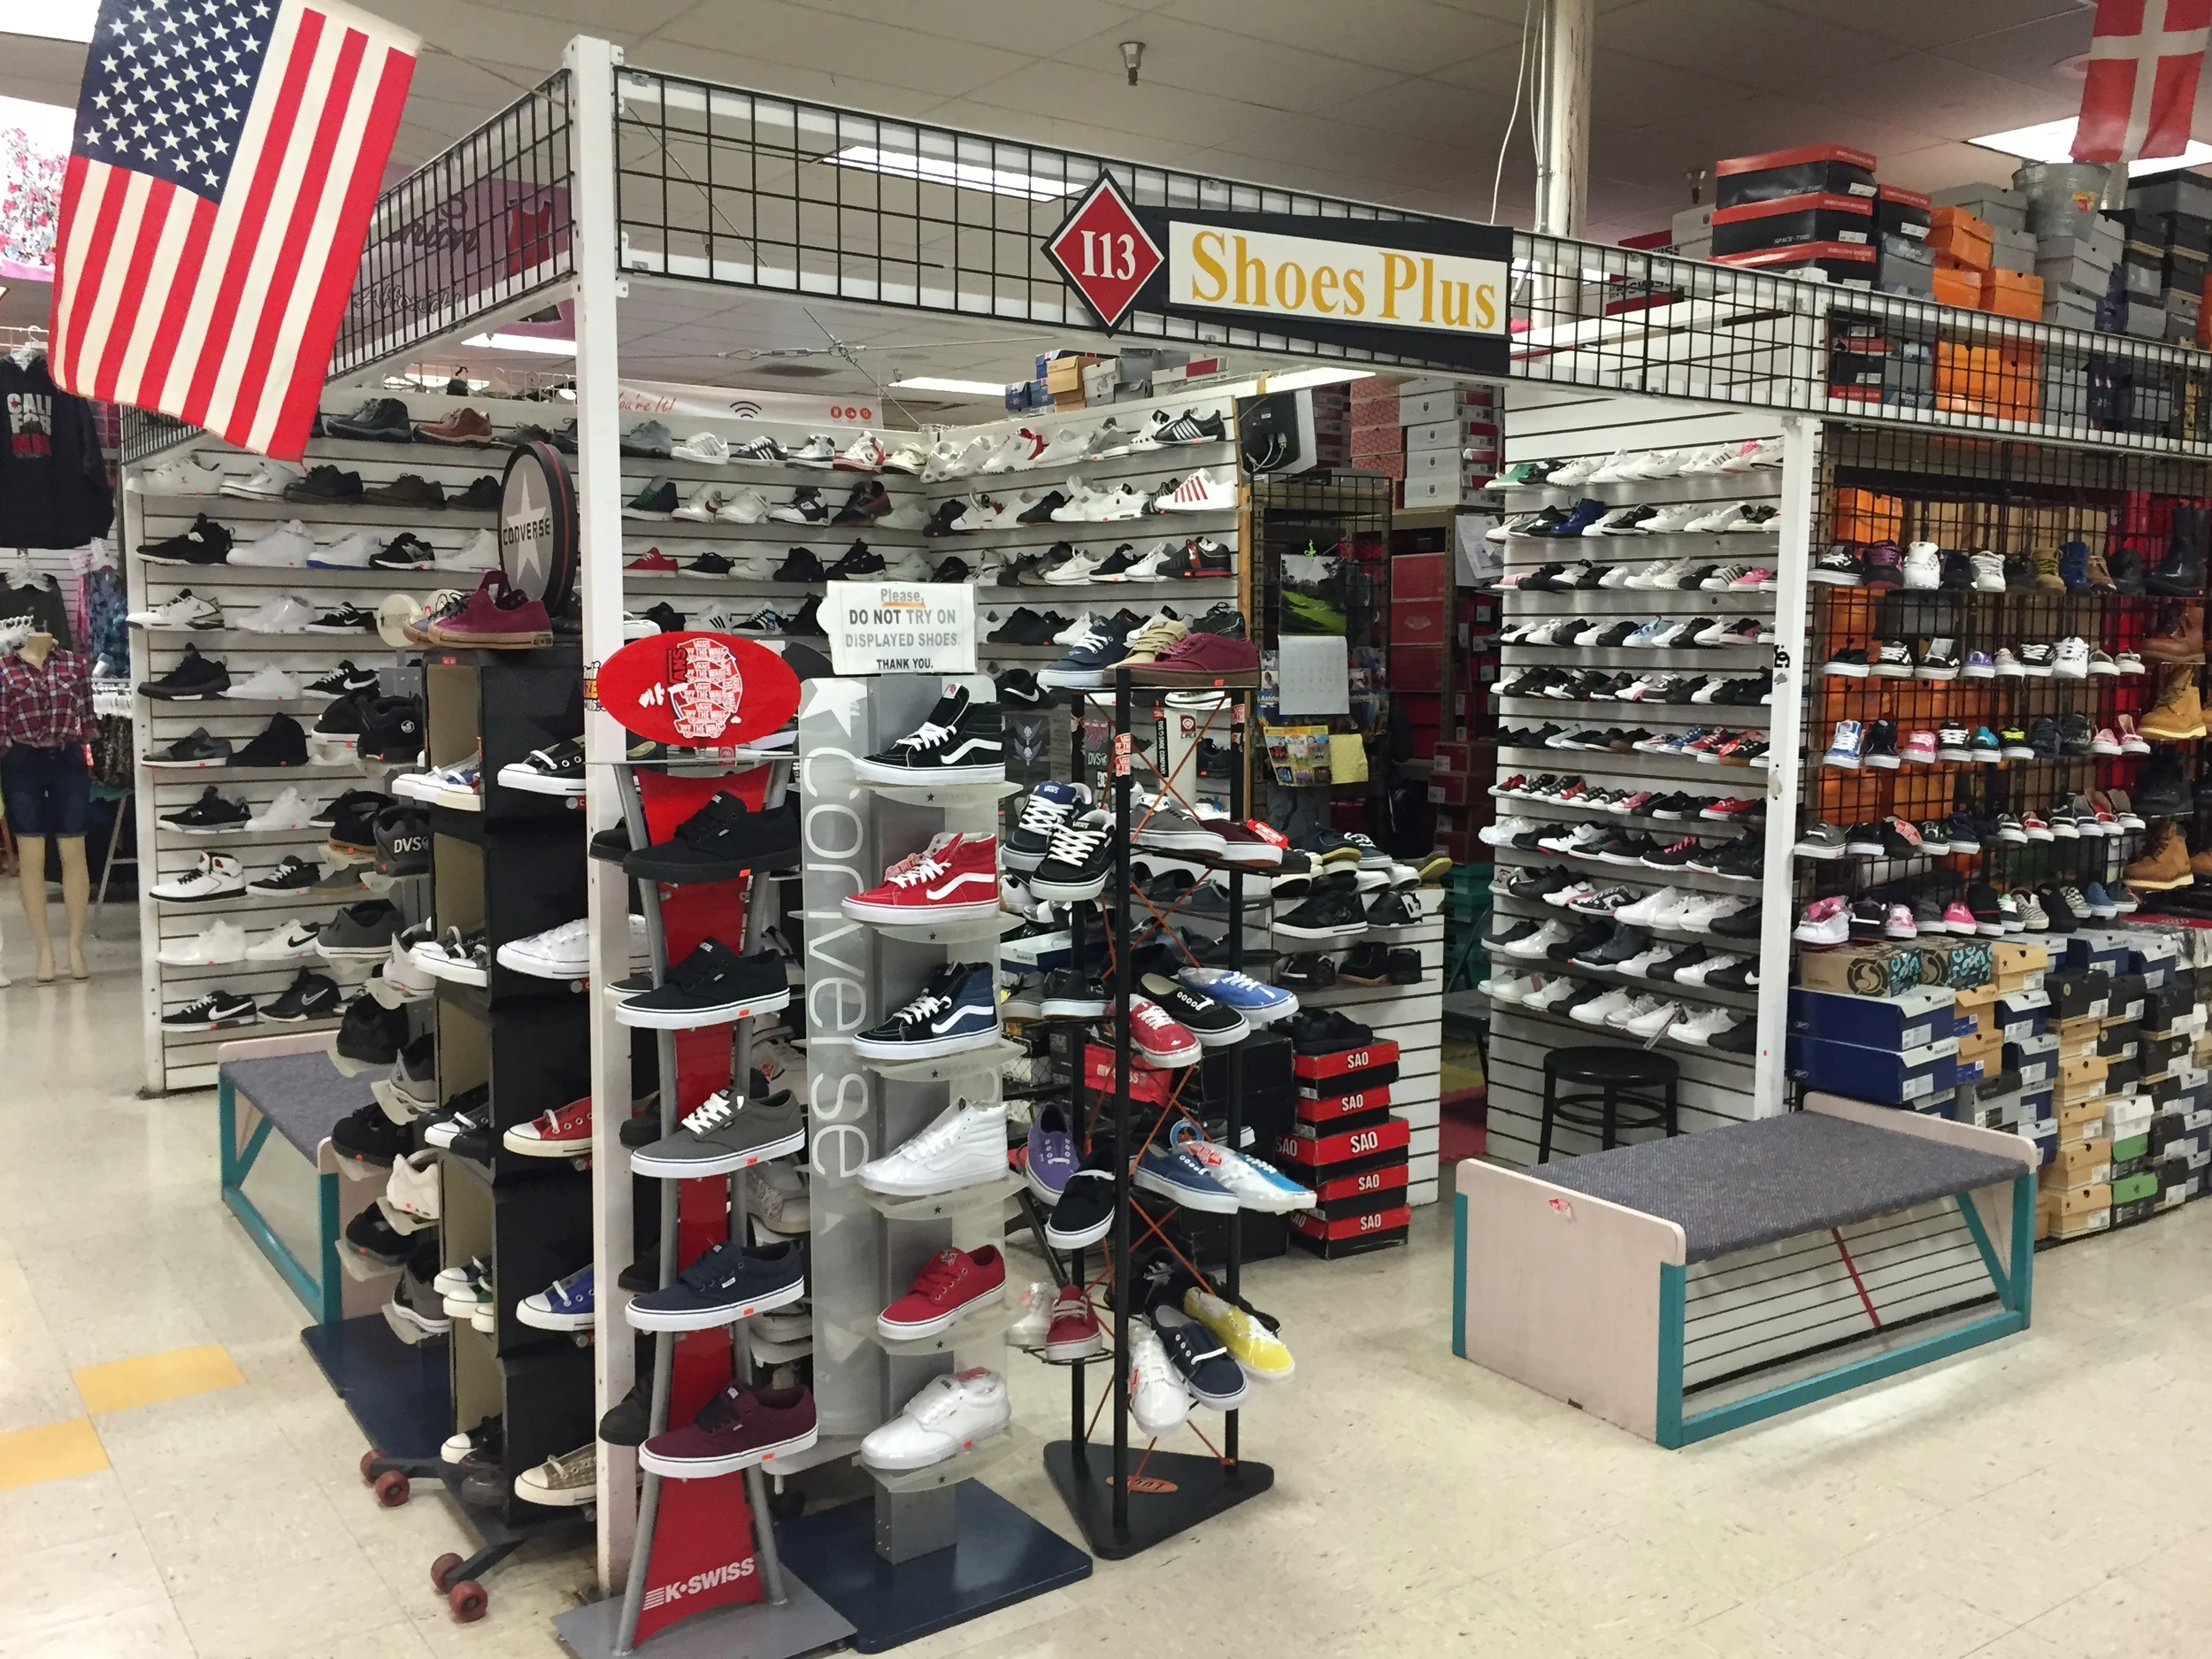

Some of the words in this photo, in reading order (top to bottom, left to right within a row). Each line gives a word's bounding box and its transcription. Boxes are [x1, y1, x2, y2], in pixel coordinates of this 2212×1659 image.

[1191, 230, 1365, 317] Shoes
[1377, 251, 1496, 330] Plus
[7, 393, 52, 416] CALI
[503, 518, 550, 546] CONVERSE
[880, 588, 925, 604] Please,
[849, 609, 868, 625] DO
[873, 609, 902, 625] NOT
[906, 609, 933, 625] TRY
[937, 609, 956, 625] ON
[876, 658, 910, 670] THANK
[913, 657, 933, 669] YOU.
[394, 836, 422, 854] DVS
[1347, 1051, 1370, 1069] SAO
[1341, 1094, 1363, 1111] SAO
[1349, 1131, 1379, 1154] SAO
[1358, 1173, 1380, 1191] SAO
[1360, 1213, 1382, 1231] SAO
